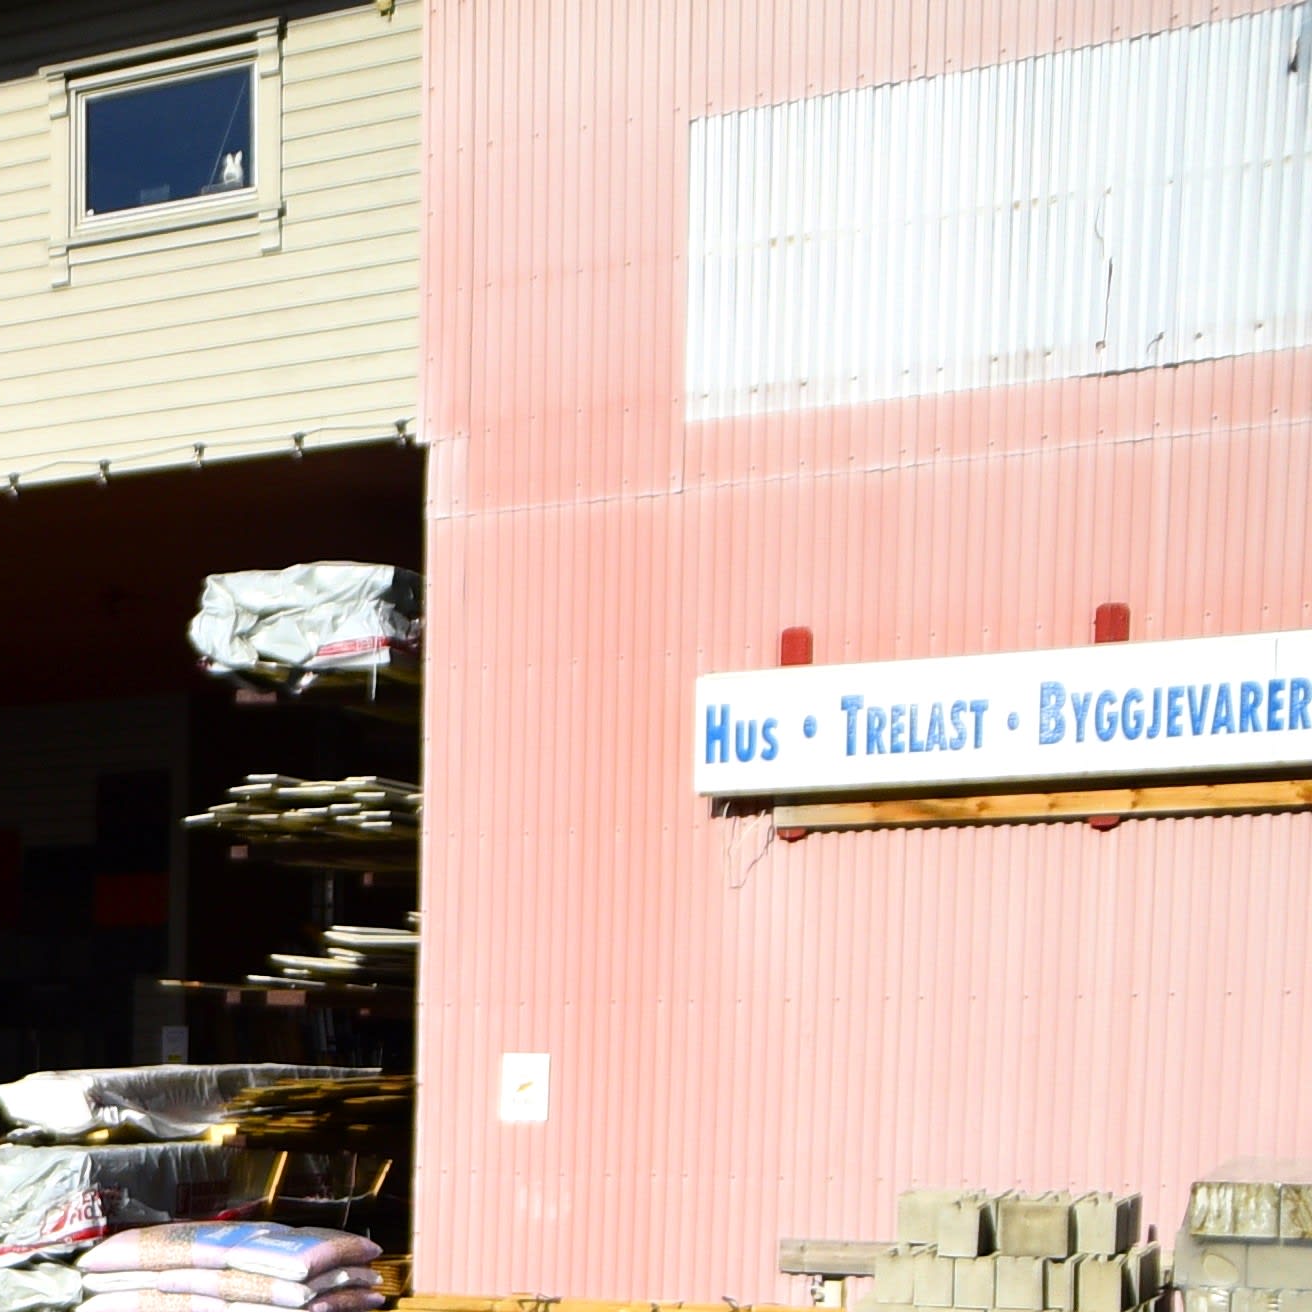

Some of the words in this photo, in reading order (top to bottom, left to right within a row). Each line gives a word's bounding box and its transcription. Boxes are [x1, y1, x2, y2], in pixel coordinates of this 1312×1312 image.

[705, 703, 779, 764] HUS
[840, 694, 989, 756] TRELAST
[1038, 677, 1312, 745] BYGGJEVARER
